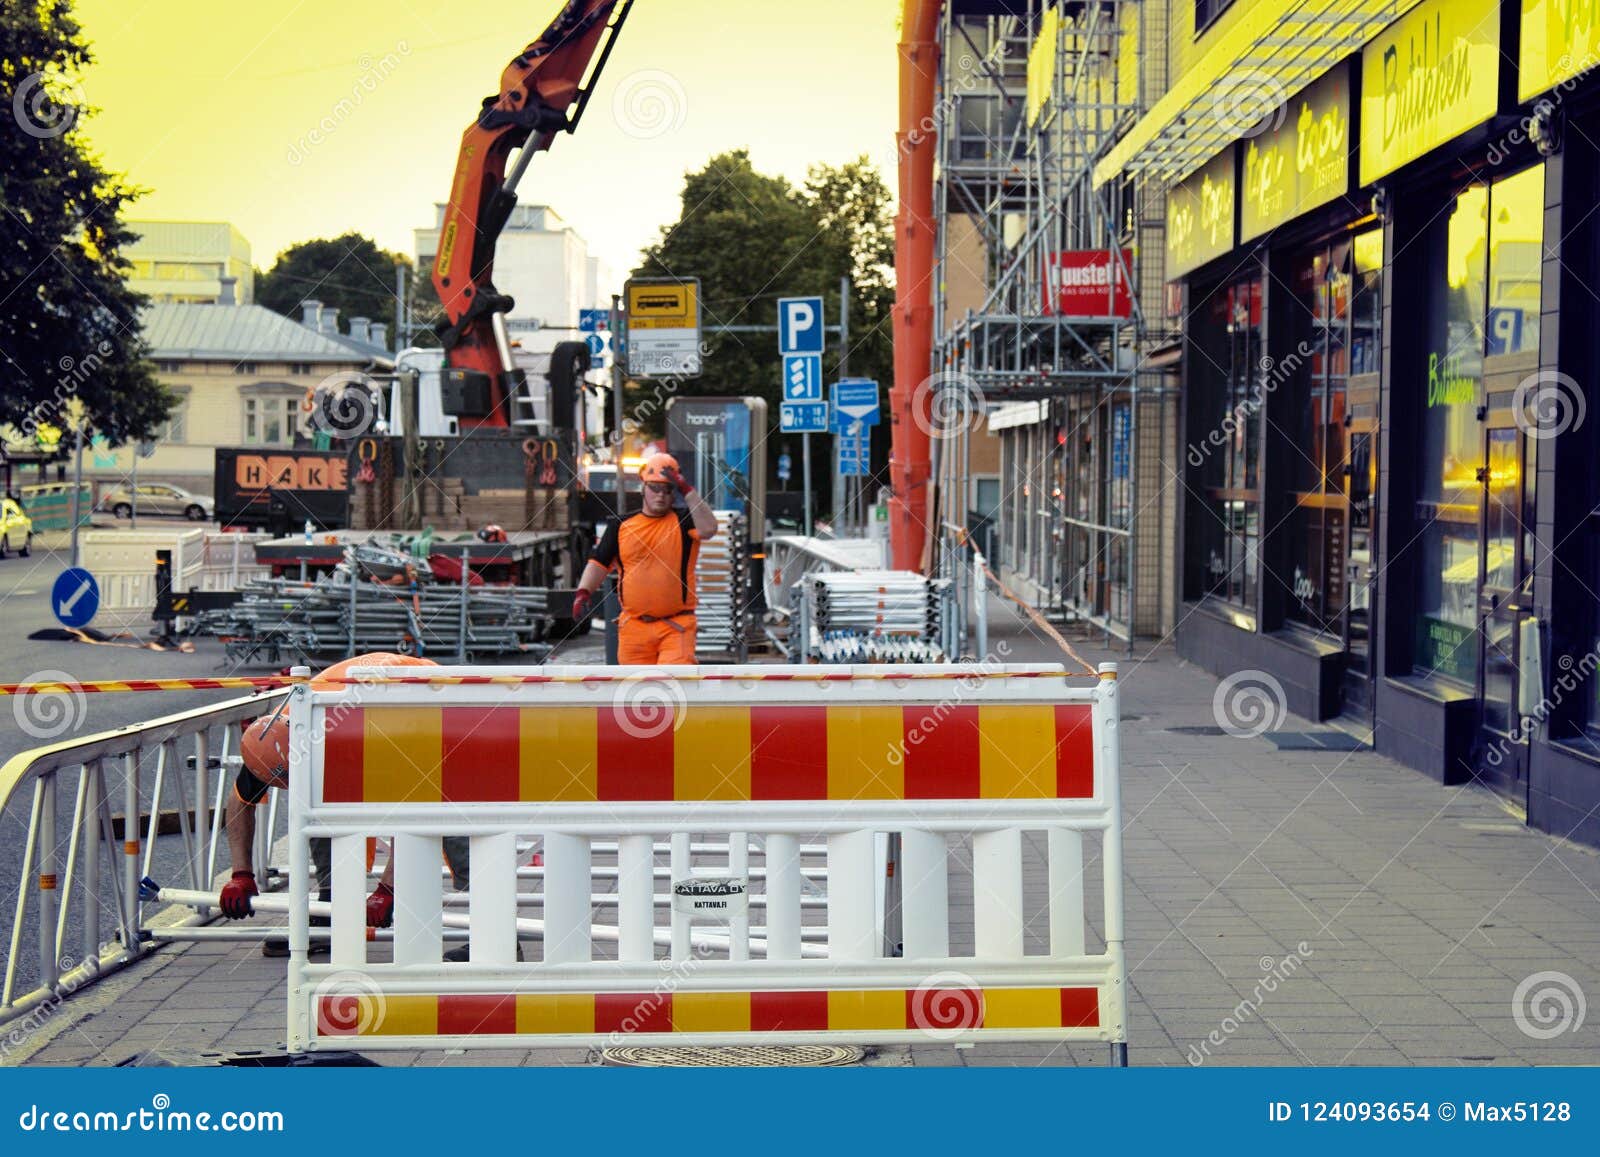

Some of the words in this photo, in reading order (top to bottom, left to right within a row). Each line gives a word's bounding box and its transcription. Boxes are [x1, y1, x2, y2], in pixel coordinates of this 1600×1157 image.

[788, 302, 814, 350] P
[686, 411, 718, 425] honor
[694, 901, 727, 909] KATTAVA.FI
